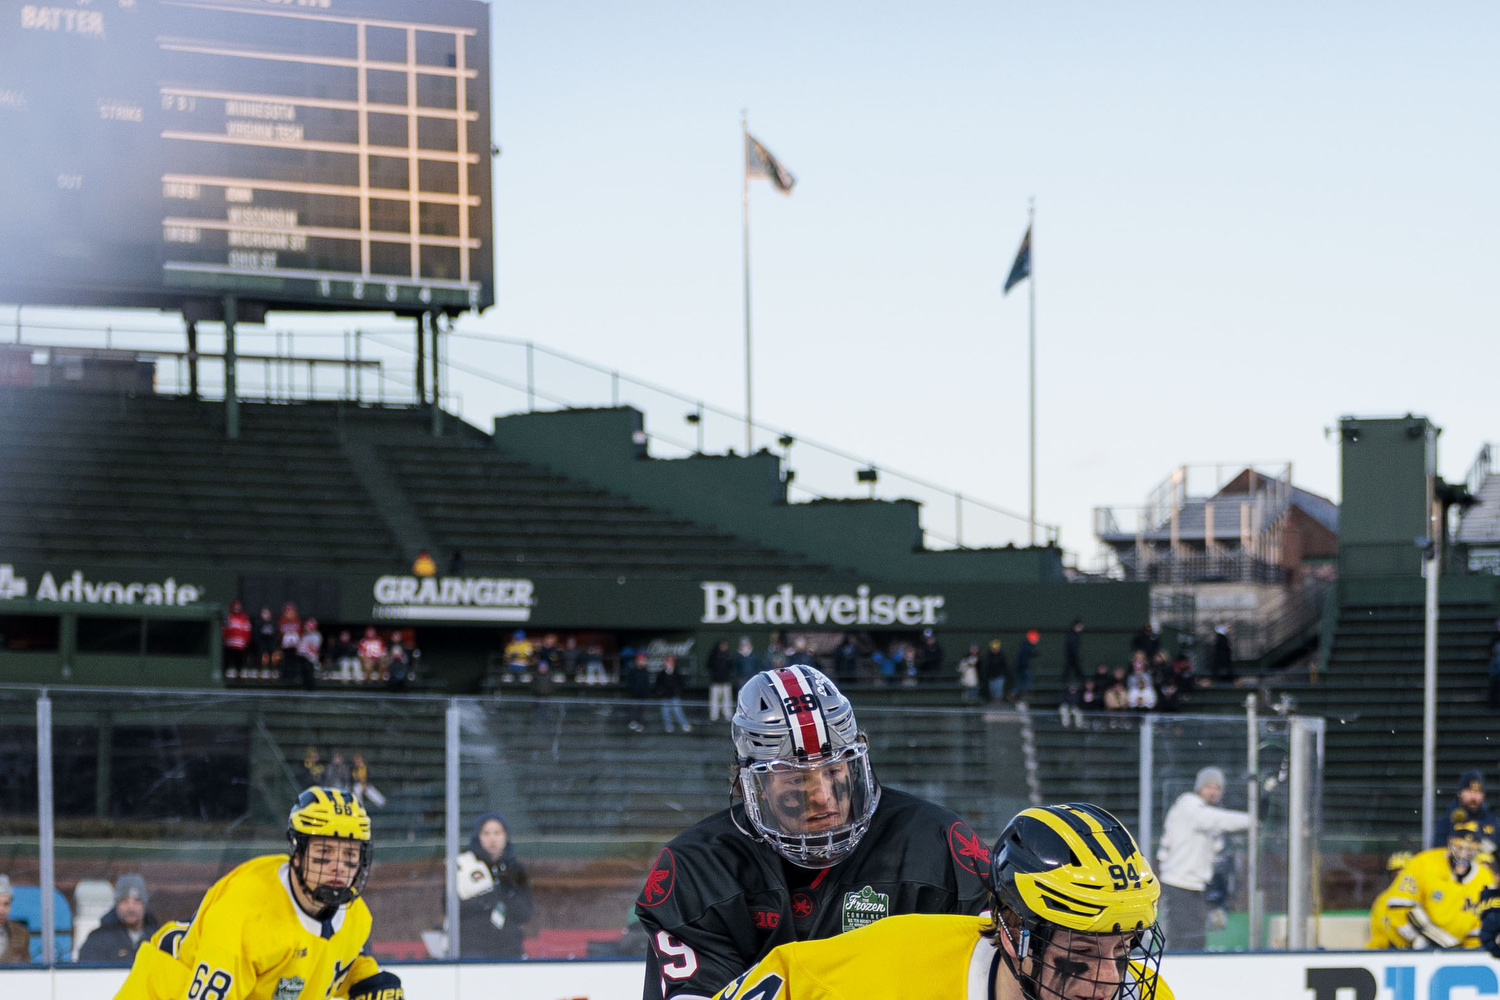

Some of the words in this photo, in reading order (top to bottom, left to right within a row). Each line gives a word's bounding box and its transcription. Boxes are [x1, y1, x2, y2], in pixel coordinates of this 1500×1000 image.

[36, 570, 200, 606] Advocate
[373, 575, 534, 606] GRAINGER
[701, 581, 945, 625] Budweiser
[783, 693, 818, 715] 29
[1108, 862, 1142, 891] 94
[845, 894, 886, 912] Frozen
